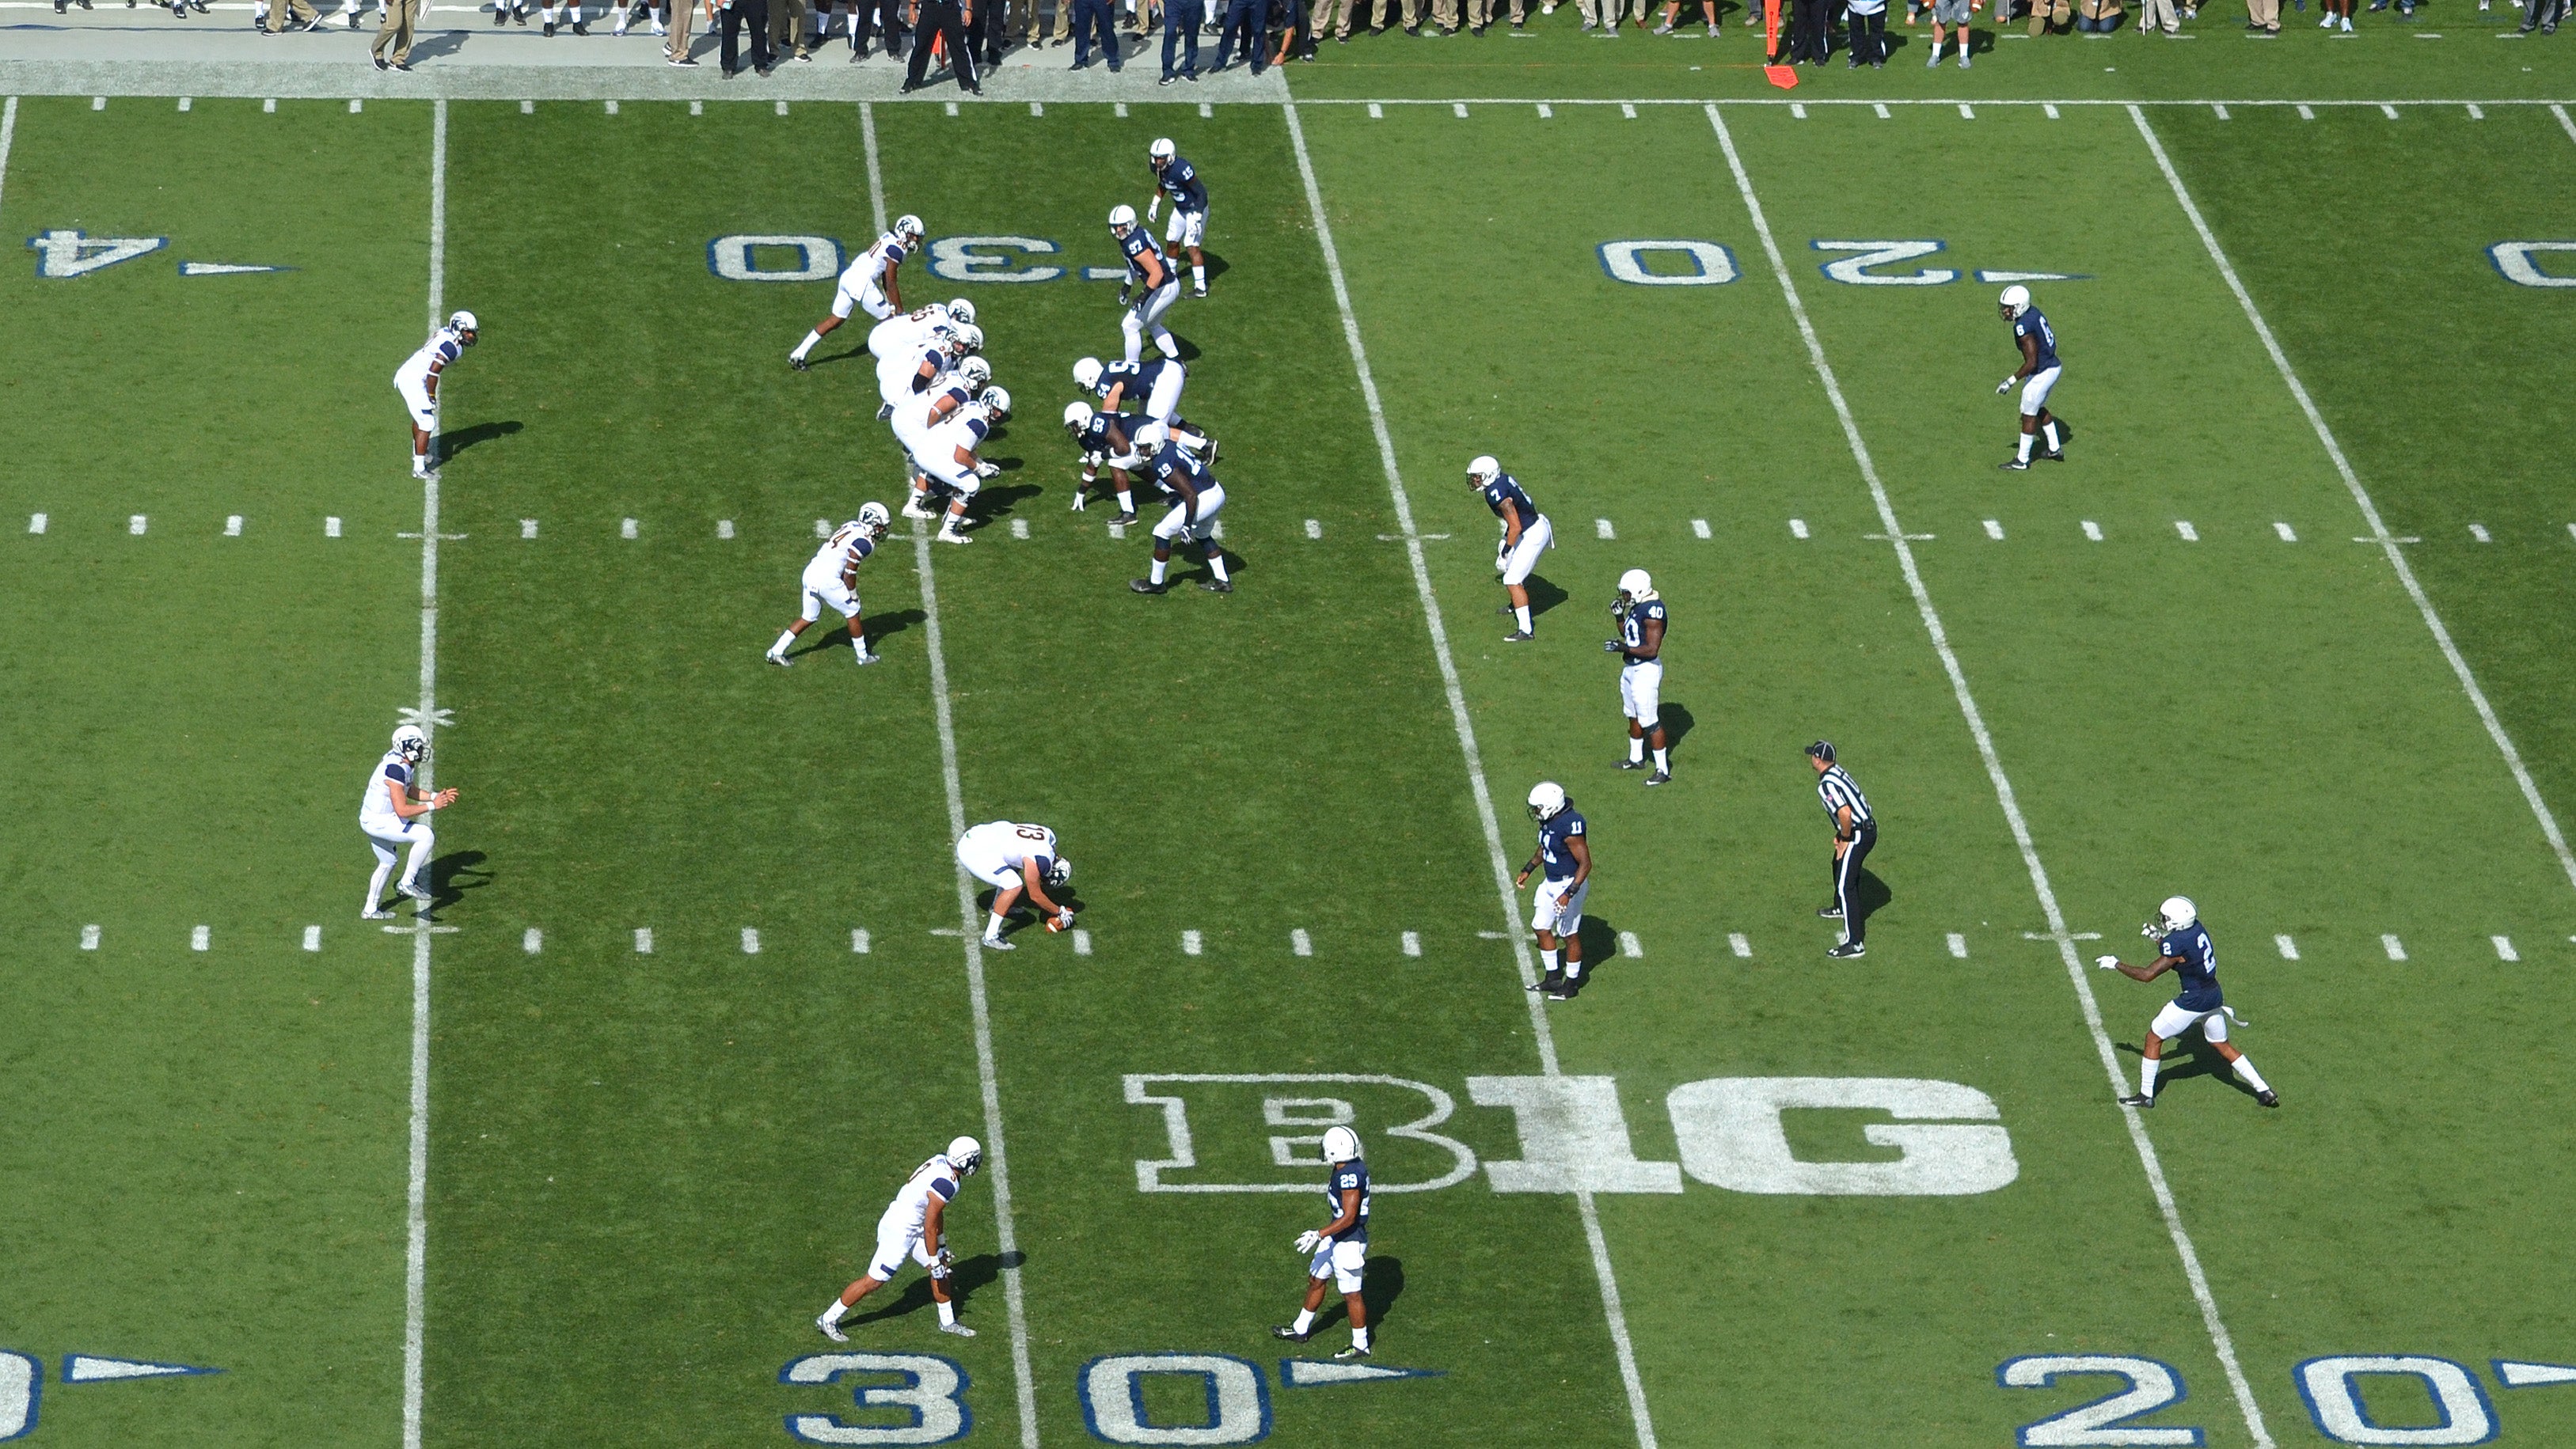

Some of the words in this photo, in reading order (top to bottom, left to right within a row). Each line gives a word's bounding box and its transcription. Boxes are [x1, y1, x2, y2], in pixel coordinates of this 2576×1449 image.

[1181, 165, 1195, 180] 15
[1128, 239, 1143, 255] 97
[2016, 324, 2025, 336] 6
[1097, 383, 1111, 399] 54
[1092, 417, 1105, 433] 93
[1157, 463, 1172, 478] 19
[1490, 488, 1502, 502] 7
[1648, 605, 1663, 619] 40
[1571, 821, 1582, 835] 11
[2163, 942, 2172, 955] 2
[2197, 932, 2217, 973] 2
[1339, 1173, 1358, 1189] 29
